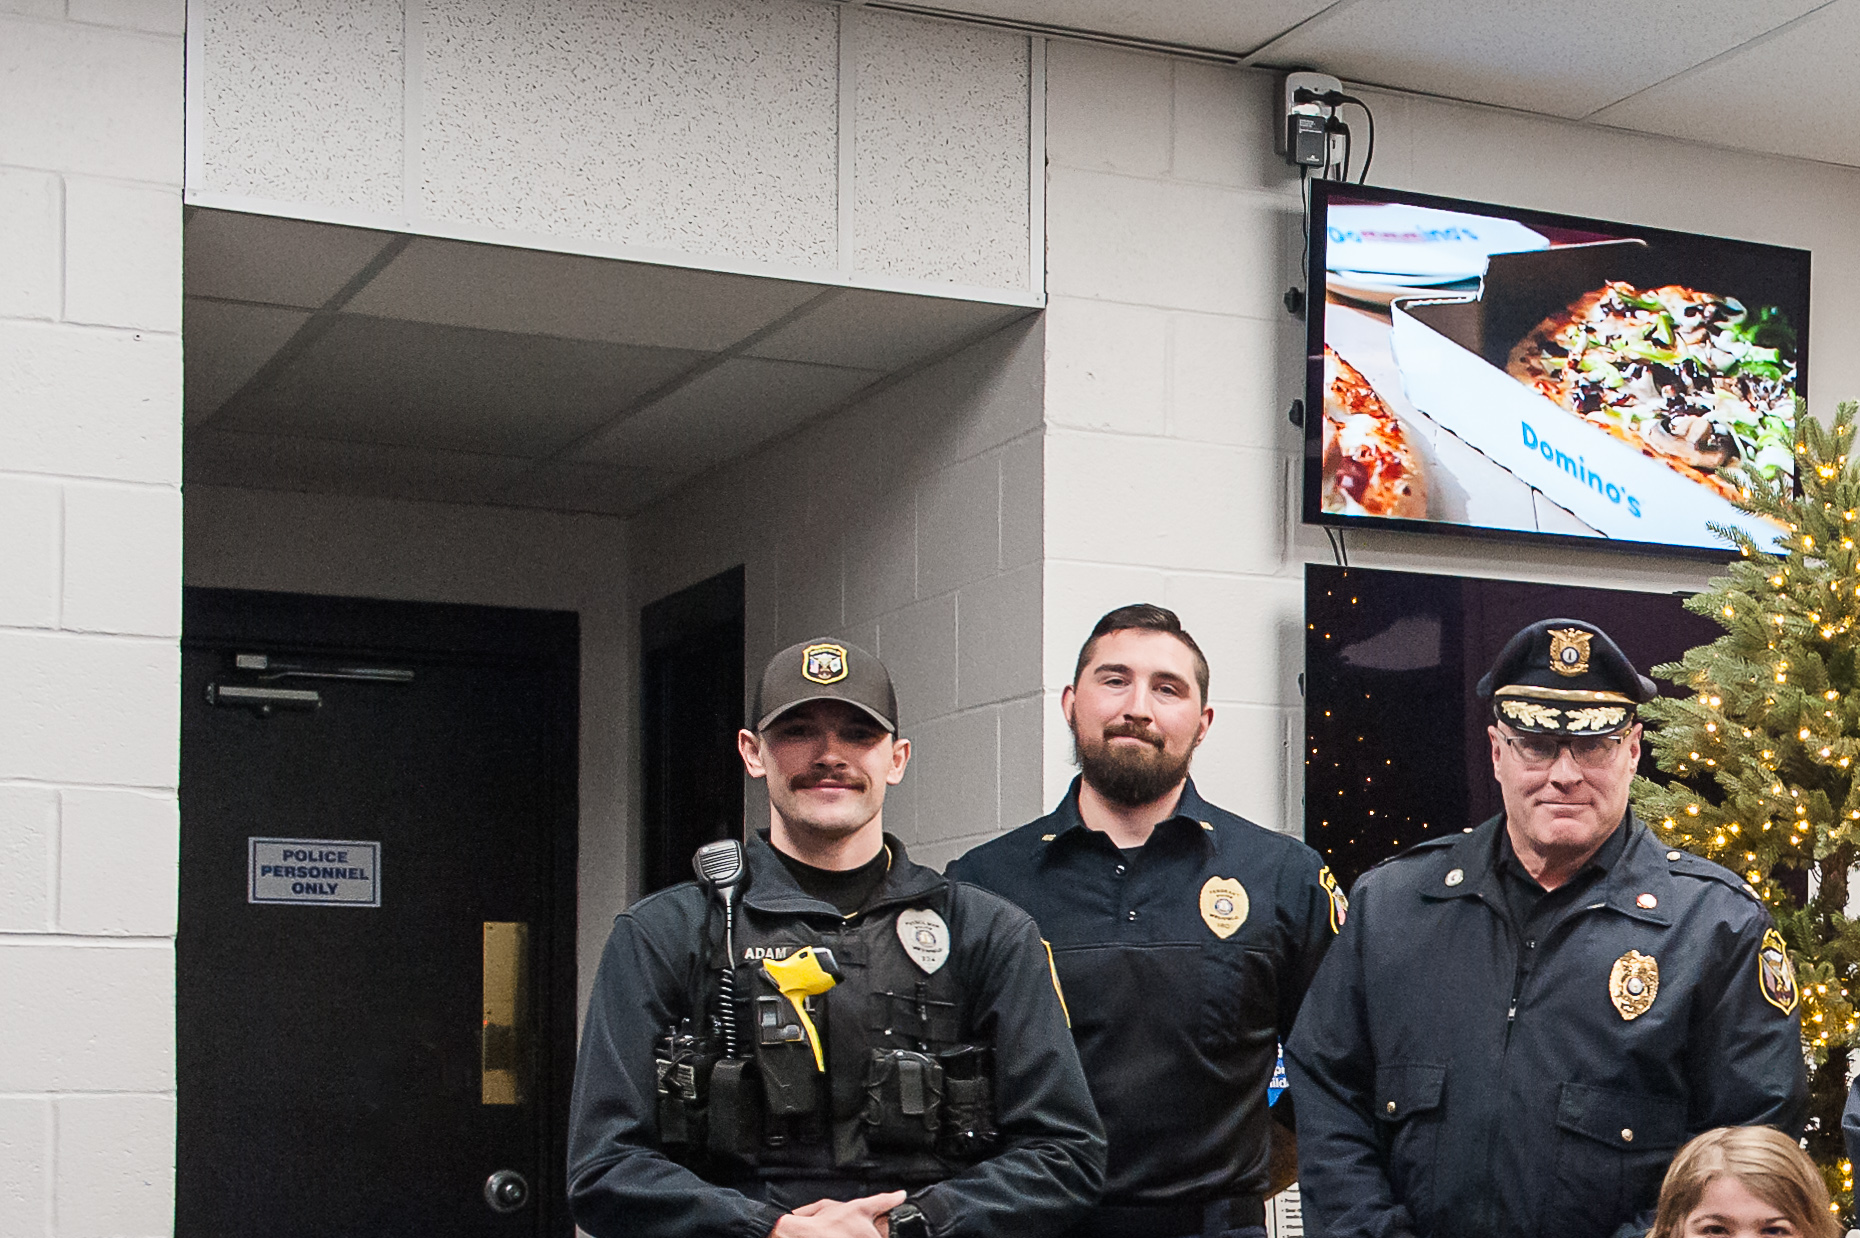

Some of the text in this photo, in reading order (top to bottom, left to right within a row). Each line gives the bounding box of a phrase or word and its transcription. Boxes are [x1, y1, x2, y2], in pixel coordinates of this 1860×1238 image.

[1520, 420, 1643, 519] Domino's
[283, 849, 349, 863] POLICE
[260, 865, 370, 881] PERSONNEL
[291, 881, 339, 896] ONLY
